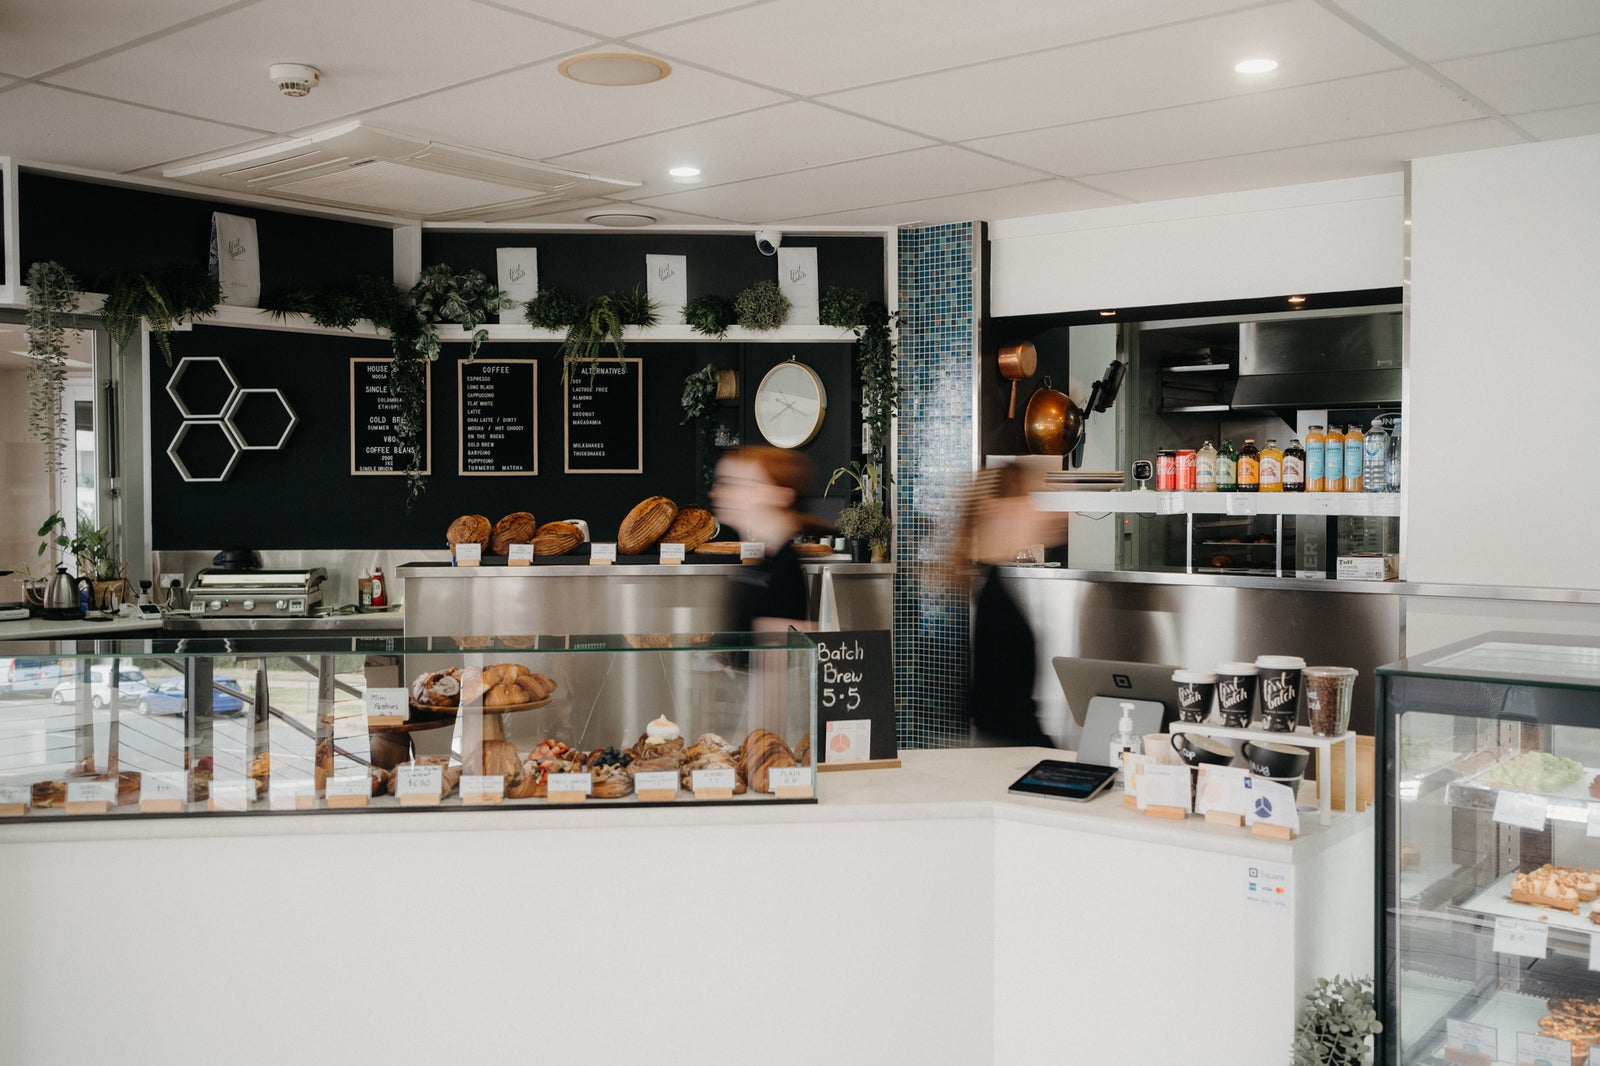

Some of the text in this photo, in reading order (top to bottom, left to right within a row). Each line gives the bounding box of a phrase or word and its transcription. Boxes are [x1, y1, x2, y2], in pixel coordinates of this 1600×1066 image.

[367, 365, 388, 373] HOUSE
[482, 366, 510, 374] COFFEE
[817, 639, 864, 662] Batch
[824, 662, 863, 684] Brew
[1219, 676, 1239, 702] first
[1223, 688, 1248, 708] batch
[1263, 672, 1287, 702] first
[1267, 685, 1296, 710] batch
[374, 702, 399, 710] Pastries
